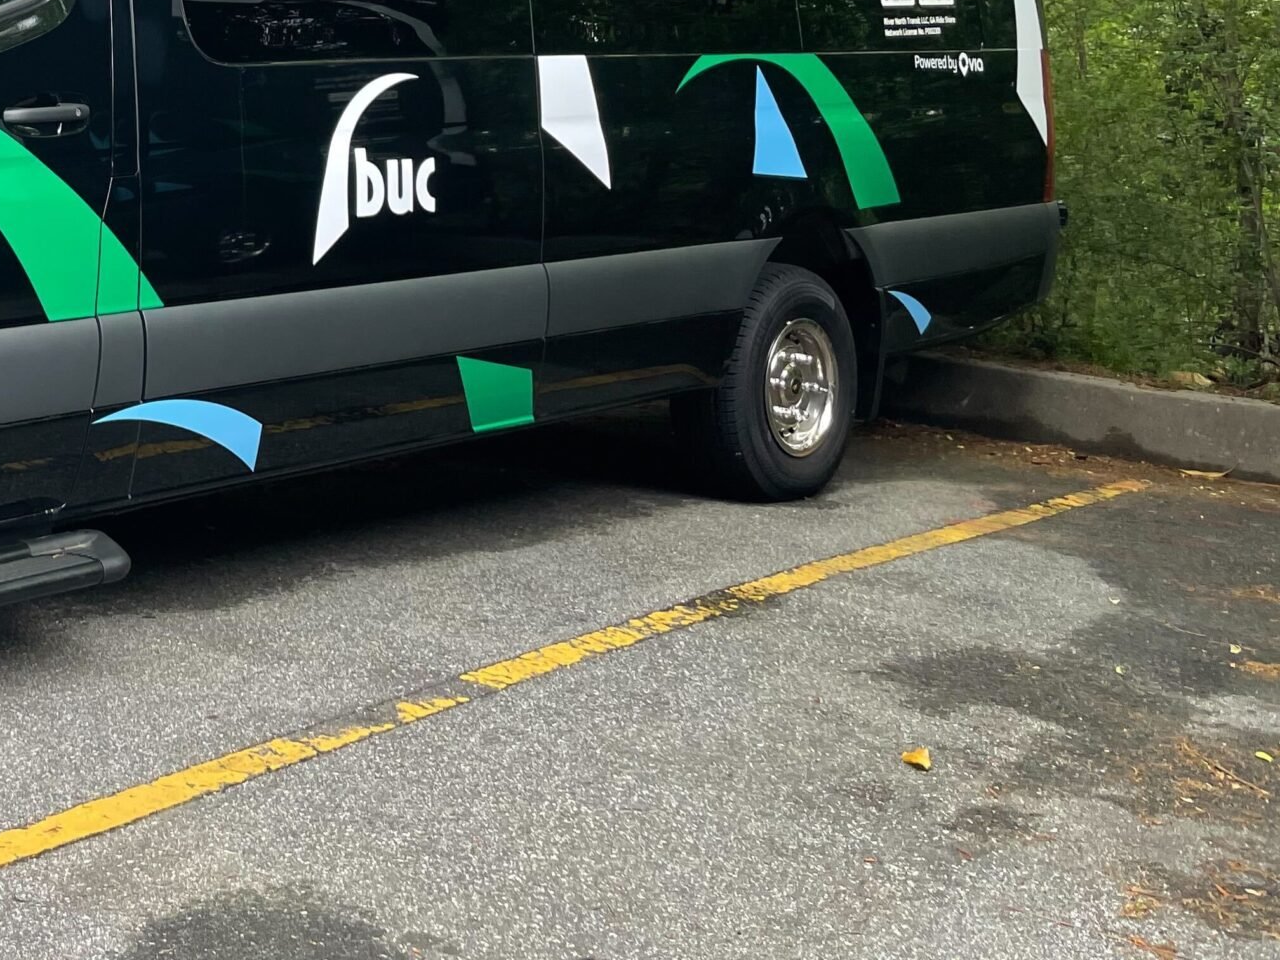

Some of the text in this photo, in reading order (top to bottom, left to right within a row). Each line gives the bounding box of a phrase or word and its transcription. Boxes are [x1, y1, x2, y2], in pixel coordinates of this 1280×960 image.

[914, 54, 947, 70] Powered
[947, 54, 958, 74] by
[353, 146, 436, 219] buc
